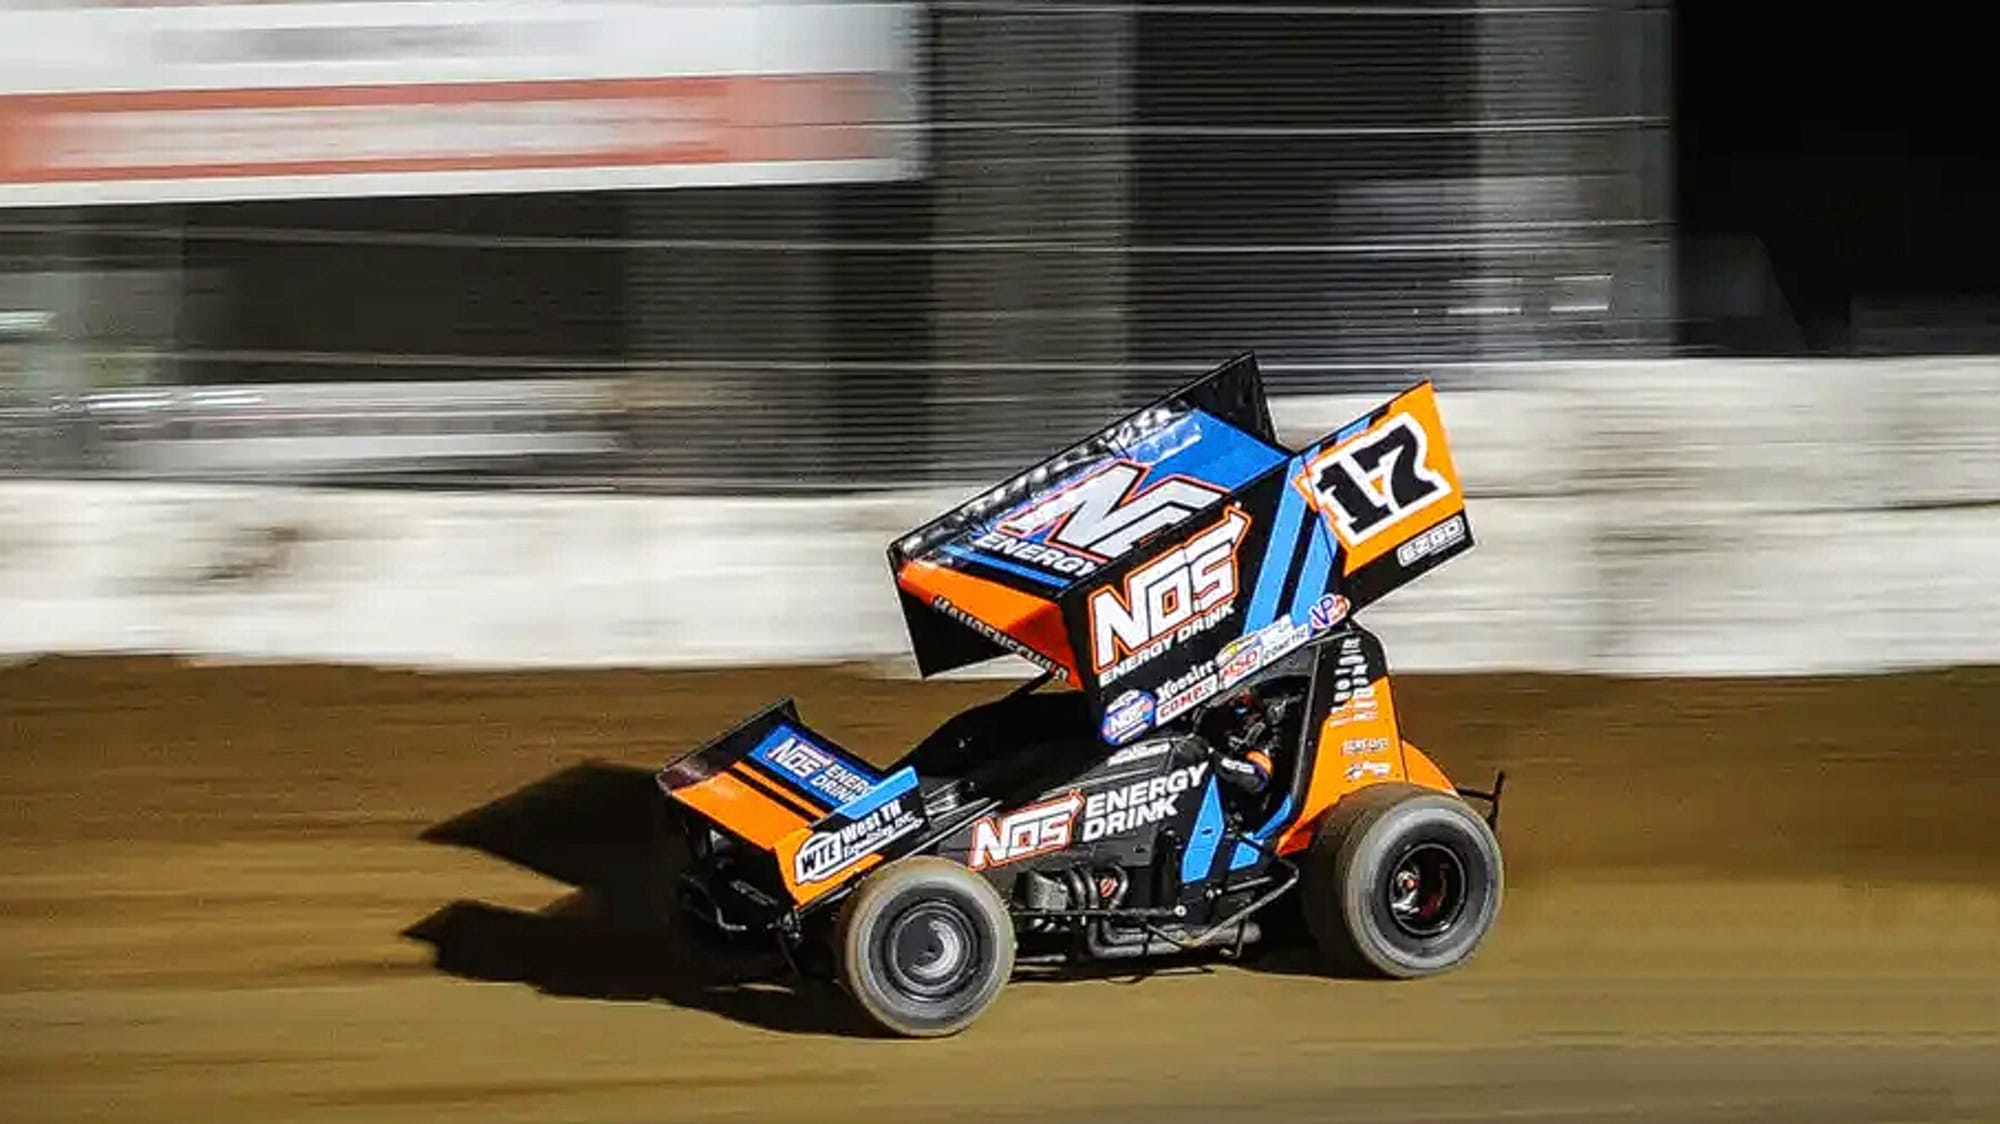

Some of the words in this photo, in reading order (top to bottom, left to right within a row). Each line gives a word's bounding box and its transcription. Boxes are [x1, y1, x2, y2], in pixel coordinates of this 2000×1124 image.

[1313, 420, 1442, 538] 17
[973, 531, 1098, 577] ENERGY
[1090, 506, 1250, 673] NOS
[1099, 633, 1177, 689] ENERGY
[1176, 600, 1236, 644] DRINK
[766, 737, 835, 778] NOS
[1082, 794, 1179, 842] DRINK
[1085, 761, 1209, 818] ENERGY
[801, 841, 839, 874] WTE
[968, 789, 1084, 871] NOS
